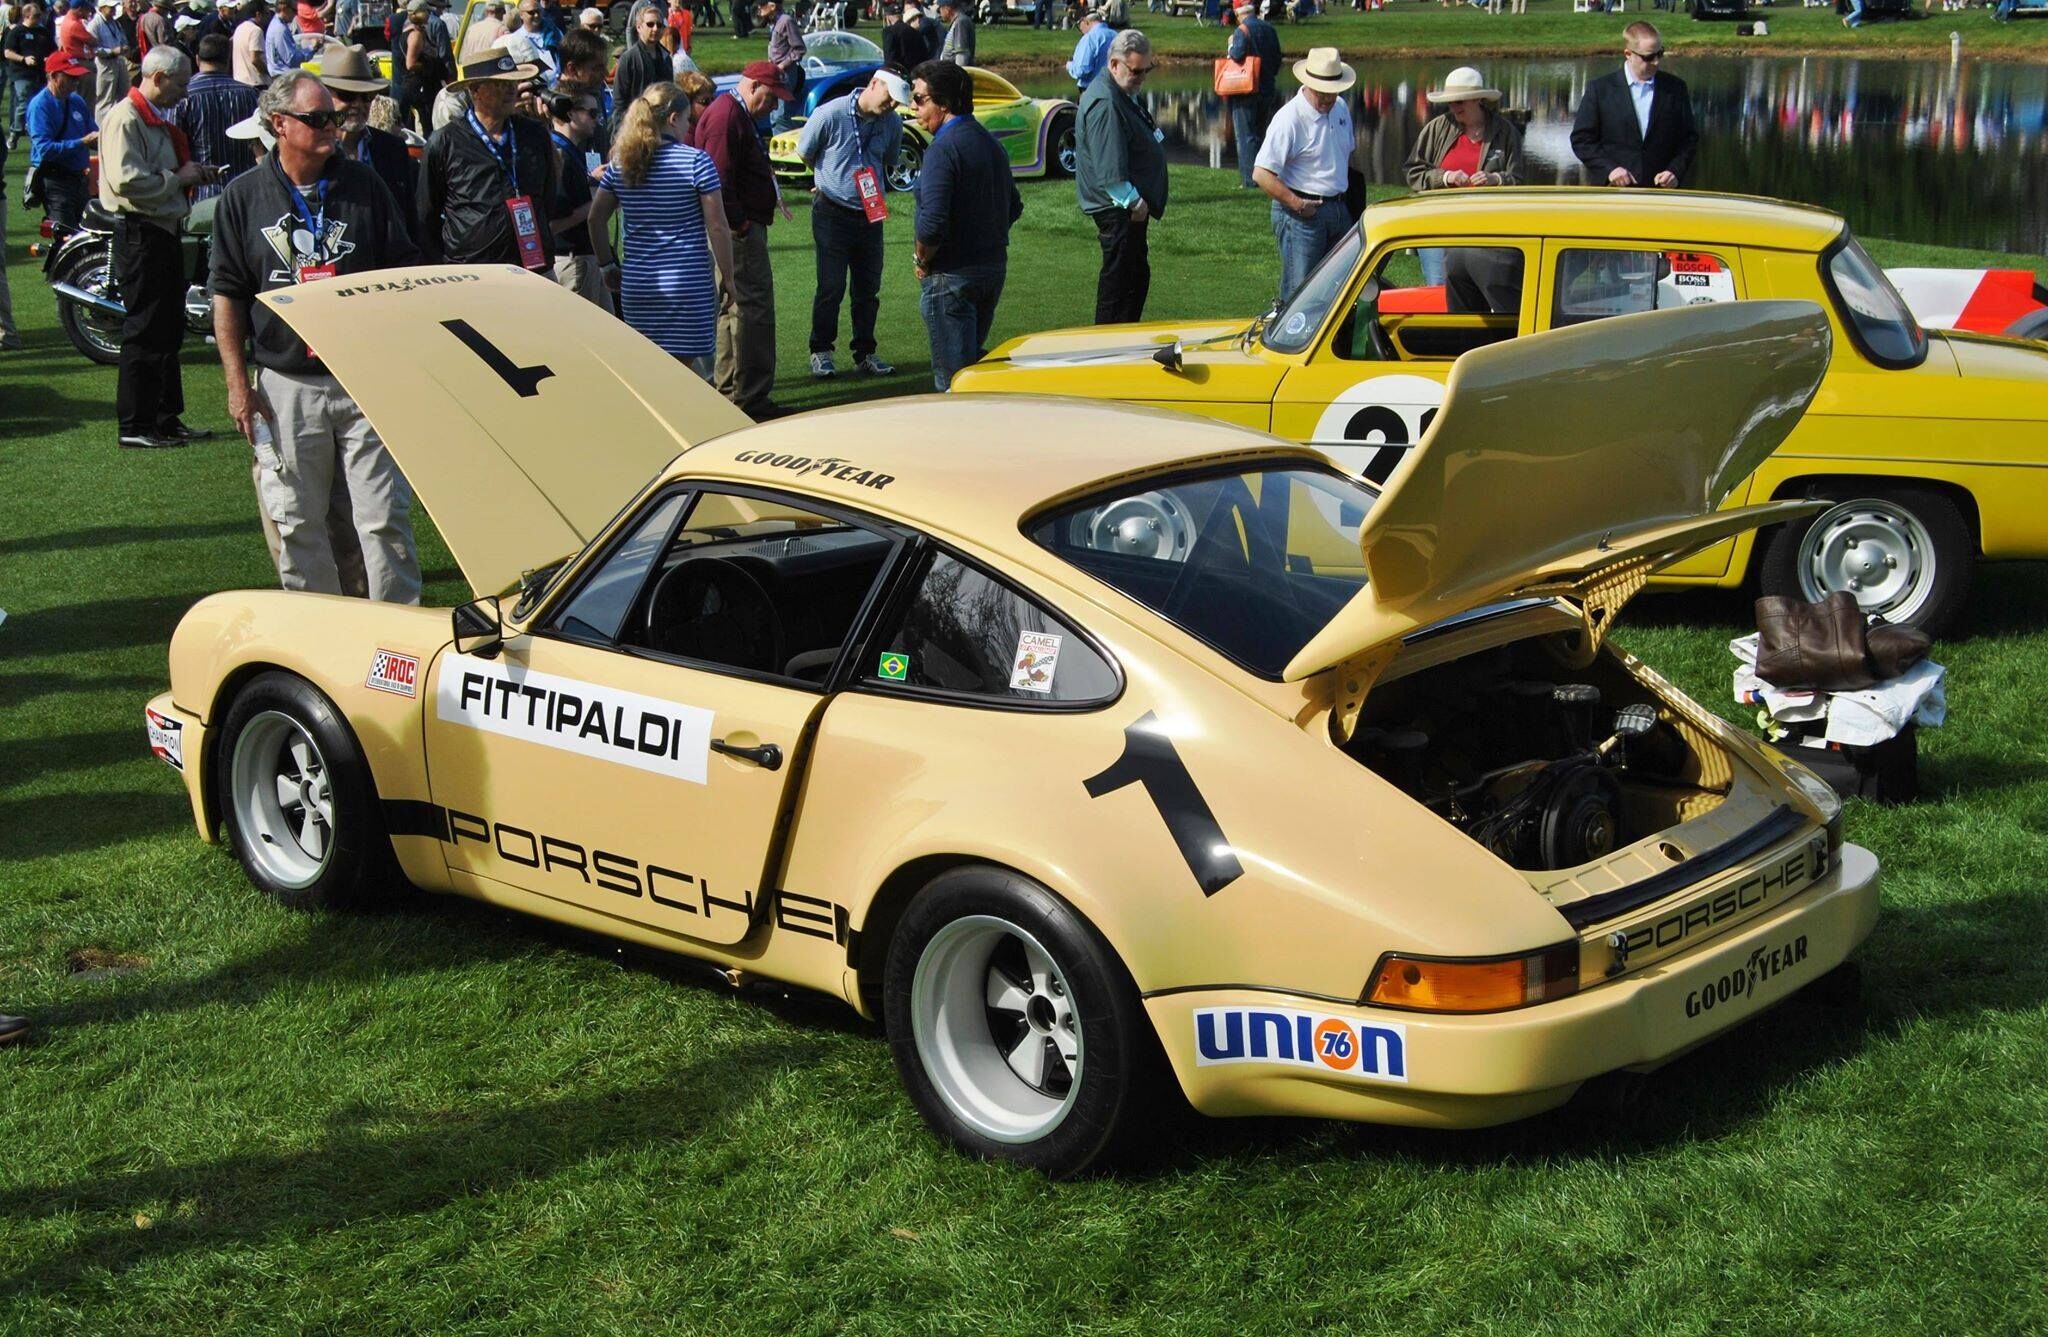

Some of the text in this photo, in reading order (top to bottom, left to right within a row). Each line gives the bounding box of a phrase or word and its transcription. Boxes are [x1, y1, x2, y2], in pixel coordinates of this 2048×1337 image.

[335, 274, 480, 297] GOODYEAR
[1676, 263, 1711, 272] BOSCH
[1678, 275, 1707, 283] BOSS
[439, 319, 556, 397] 1
[734, 450, 895, 490] GOODYEAR
[1022, 635, 1057, 648] CAMEL
[384, 656, 415, 684] IROC
[460, 672, 682, 760] FITTIPALDI
[1082, 709, 1245, 898] 1
[447, 808, 834, 942] PORSCHE
[1625, 853, 1805, 961] PORSCHE
[1685, 935, 1808, 1018] GOODYEAR
[1321, 1031, 1352, 1060] 76
